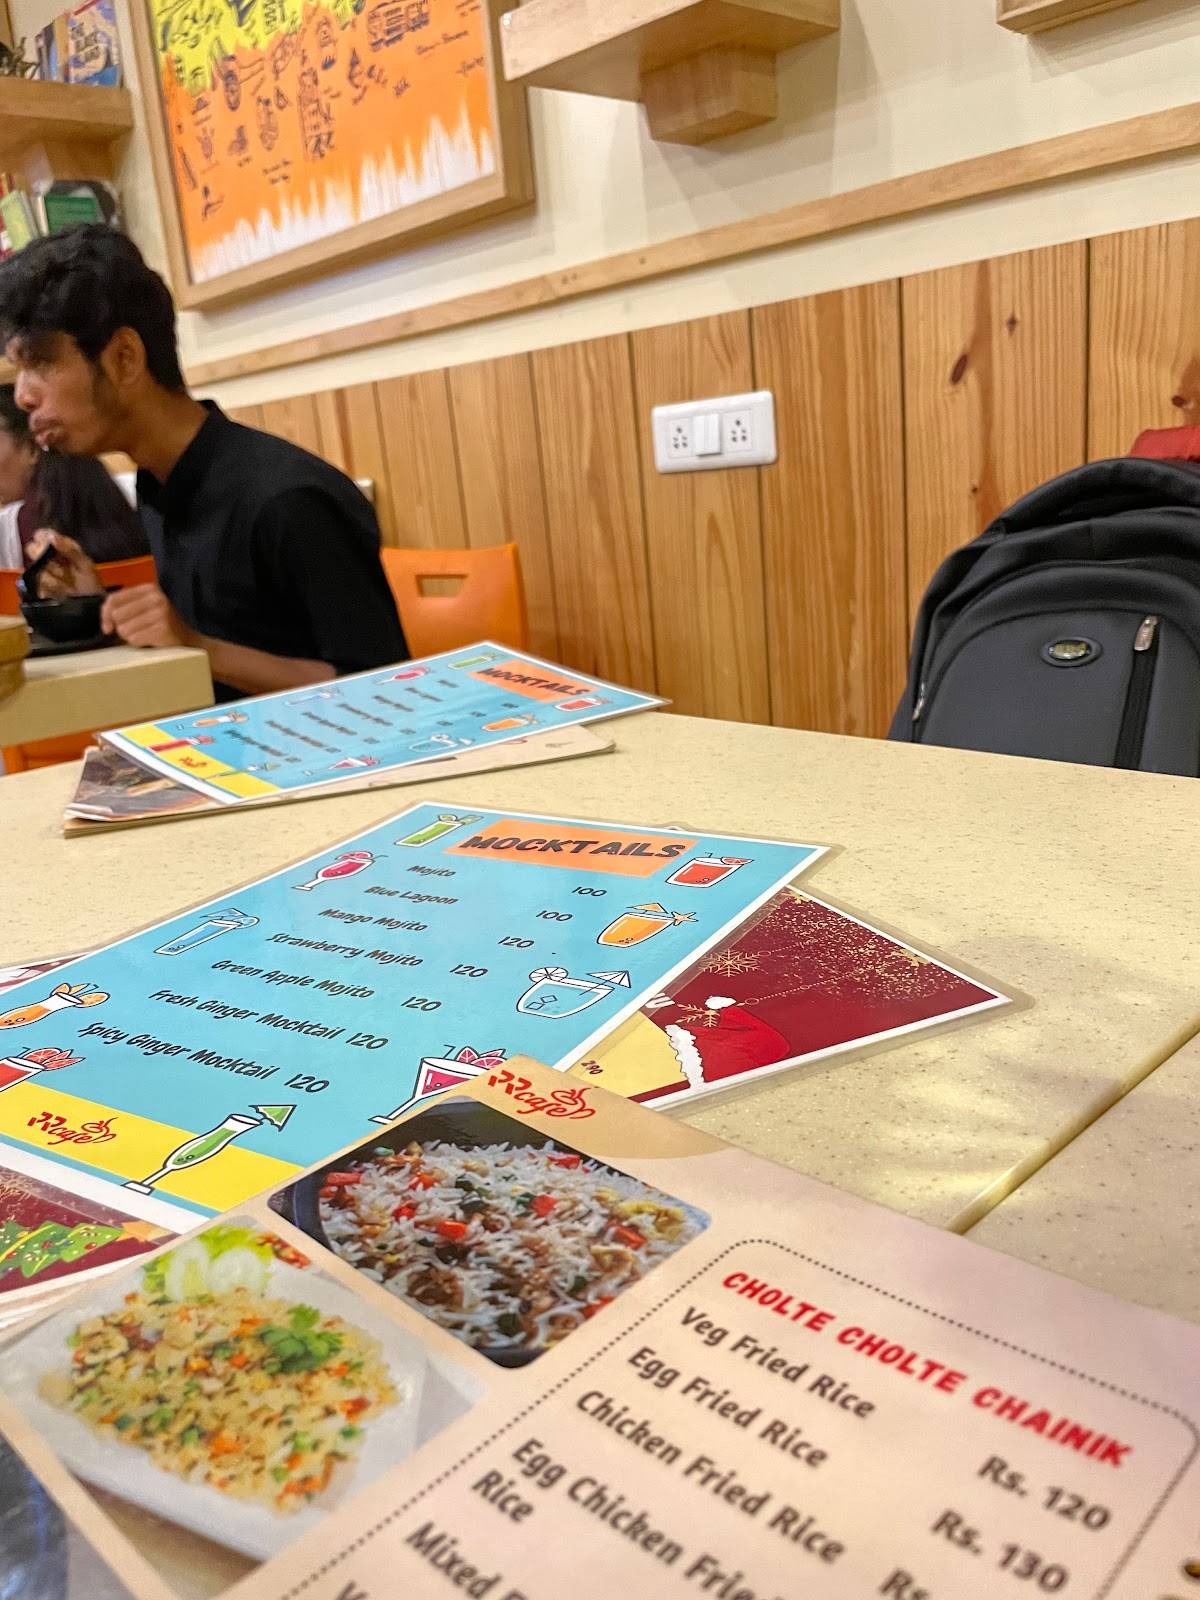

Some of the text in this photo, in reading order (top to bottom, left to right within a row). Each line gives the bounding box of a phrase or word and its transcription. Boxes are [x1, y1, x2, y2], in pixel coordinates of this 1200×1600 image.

[477, 668, 589, 695] MOCKTAILS
[459, 836, 686, 858] MOCKTAILS
[364, 886, 573, 922] Blue Lagoon 100
[407, 865, 608, 897] Mojito 100
[265, 933, 489, 978] Strawberry Mojito 120
[318, 908, 535, 948] Mango Mojito 120
[211, 960, 442, 1012] Green Apple Mojito 120
[148, 990, 389, 1050] Fresh Ginger Mocktail 120
[77, 1022, 330, 1093] Spicy Ginger Mocktail 120
[722, 1271, 1134, 1468] CHOLTE CHOLTE CHAINIK
[680, 1306, 1113, 1532] Veg Fried Rice Rs. 120
[471, 1469, 535, 1524] Rice
[575, 1389, 683, 1466] Chicken
[682, 1454, 771, 1518] Fried
[767, 1504, 846, 1564] Rice
[627, 1346, 1070, 1593] Egg Fried Rice Rs. 130
[510, 1437, 568, 1490] Egg
[567, 1475, 685, 1568] Chicken
[404, 1520, 503, 1600] Mixed
